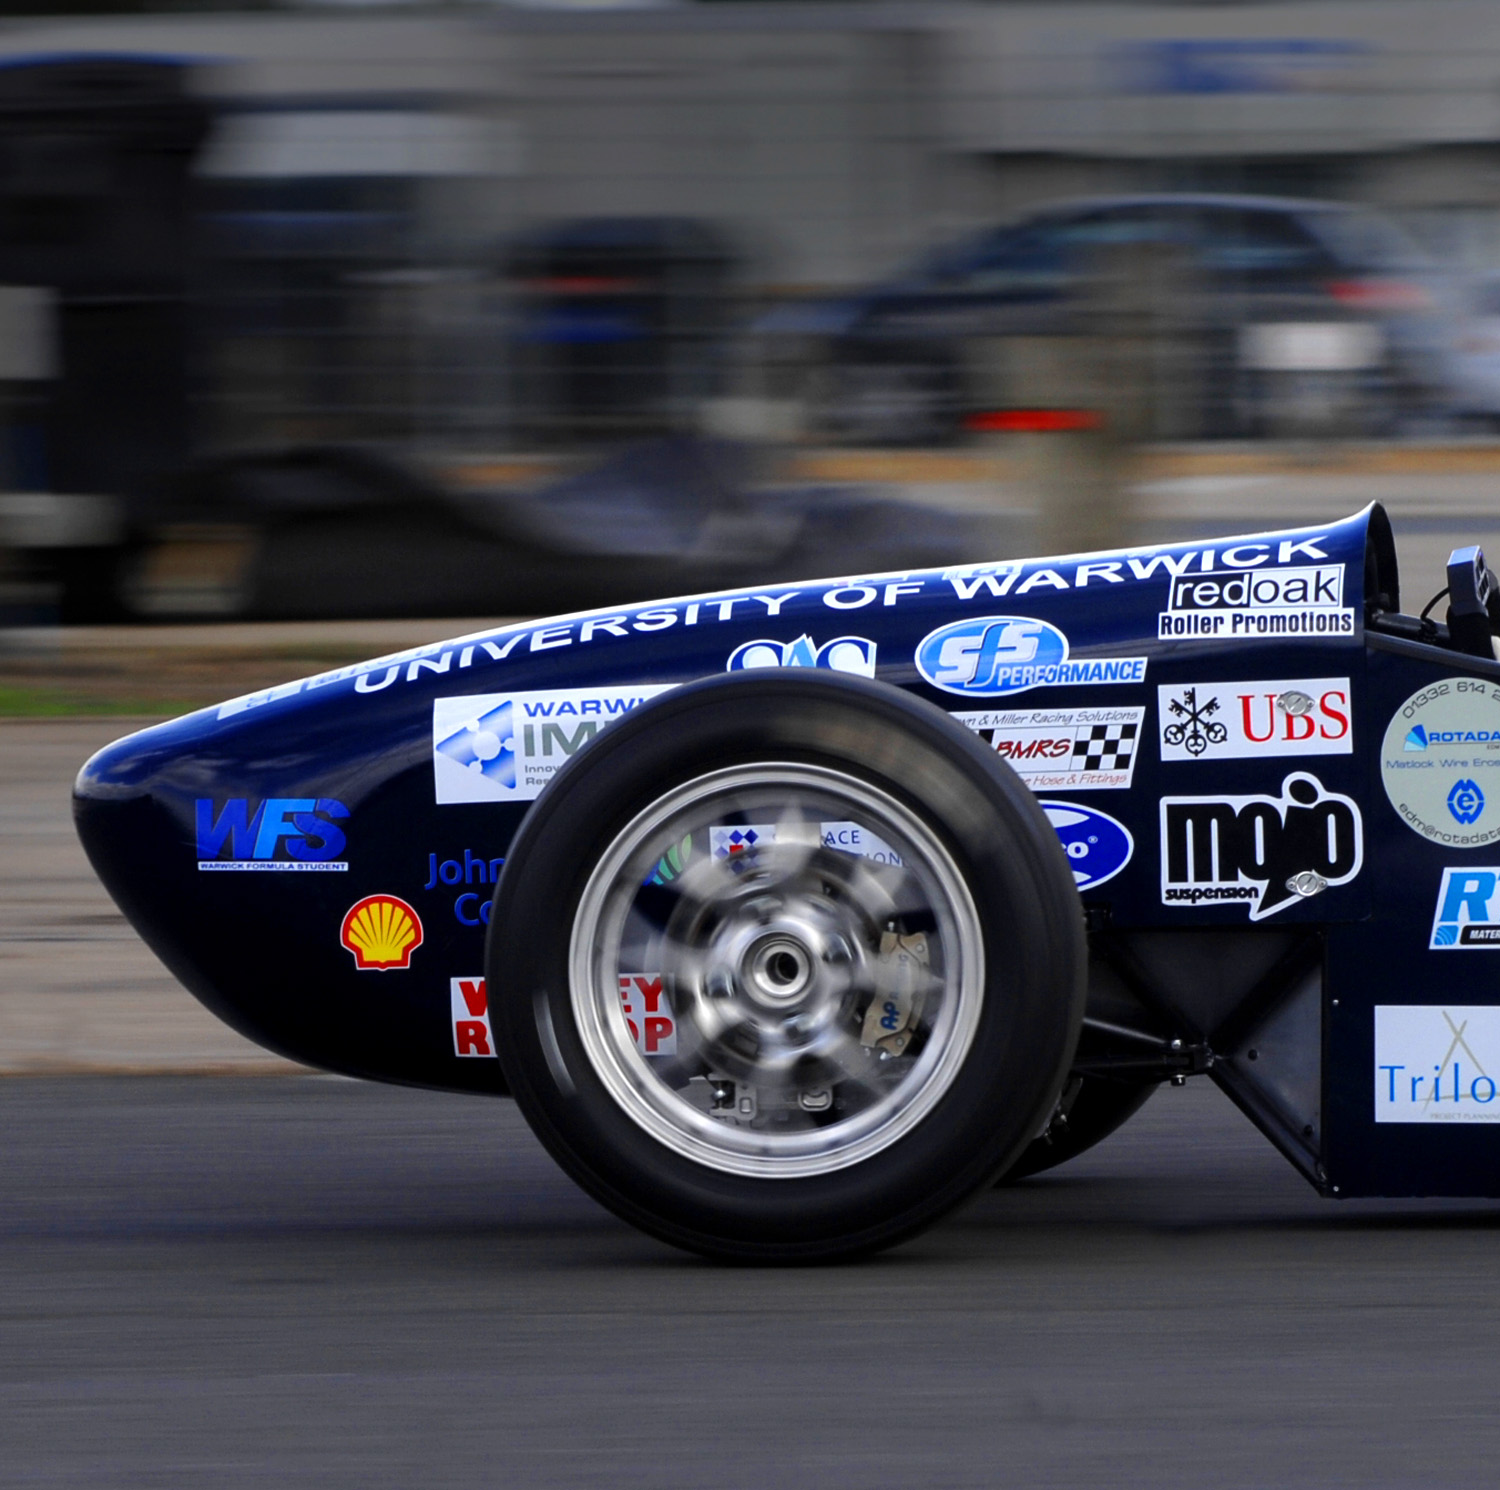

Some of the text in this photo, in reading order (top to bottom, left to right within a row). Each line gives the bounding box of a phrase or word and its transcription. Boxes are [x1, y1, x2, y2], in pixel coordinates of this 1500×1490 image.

[1176, 570, 1338, 607] redoak
[354, 592, 802, 693] UNIVERSITY
[822, 580, 925, 610] OF
[948, 535, 1329, 600] WARWICK
[1161, 611, 1352, 636] Roller Promotions
[998, 660, 1145, 687] PERFORMANCE
[1402, 683, 1451, 719] 01332
[1456, 681, 1486, 695] 614
[978, 715, 989, 725] &
[992, 713, 1028, 725] Miller
[1030, 712, 1074, 726] Racing
[1076, 710, 1138, 723] Solutions
[1237, 691, 1349, 743] UBS
[997, 738, 1071, 759] BMRS
[1386, 760, 1434, 769] Matlock
[1439, 759, 1469, 768] Wire
[1031, 775, 1065, 786] Hose
[1067, 774, 1077, 785] &
[1079, 772, 1128, 786] Fittings
[195, 798, 351, 862] WFS
[1165, 886, 1260, 904] suspension
